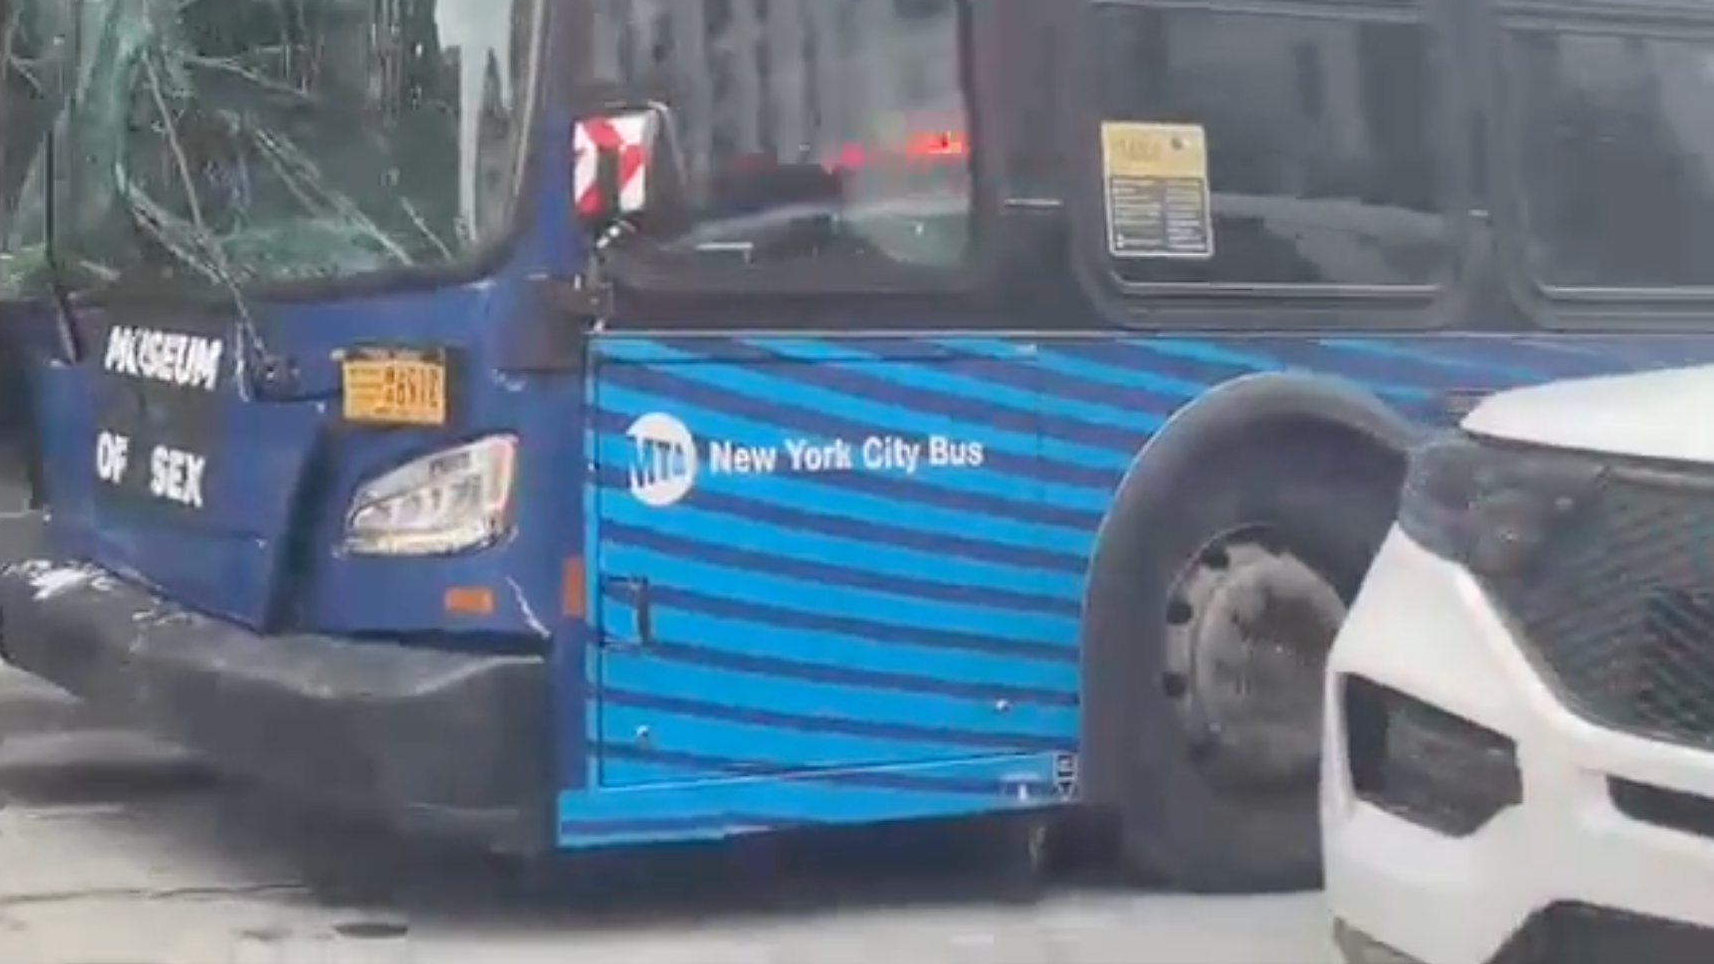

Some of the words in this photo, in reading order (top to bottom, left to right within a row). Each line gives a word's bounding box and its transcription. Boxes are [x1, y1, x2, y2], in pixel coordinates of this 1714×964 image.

[104, 325, 222, 390] MUSEUM
[96, 432, 128, 483] OF
[150, 445, 206, 508] SEX
[626, 429, 694, 492] MTA
[709, 440, 777, 474] New
[787, 439, 853, 472] York
[862, 435, 921, 474] City
[929, 435, 985, 467] Bus
